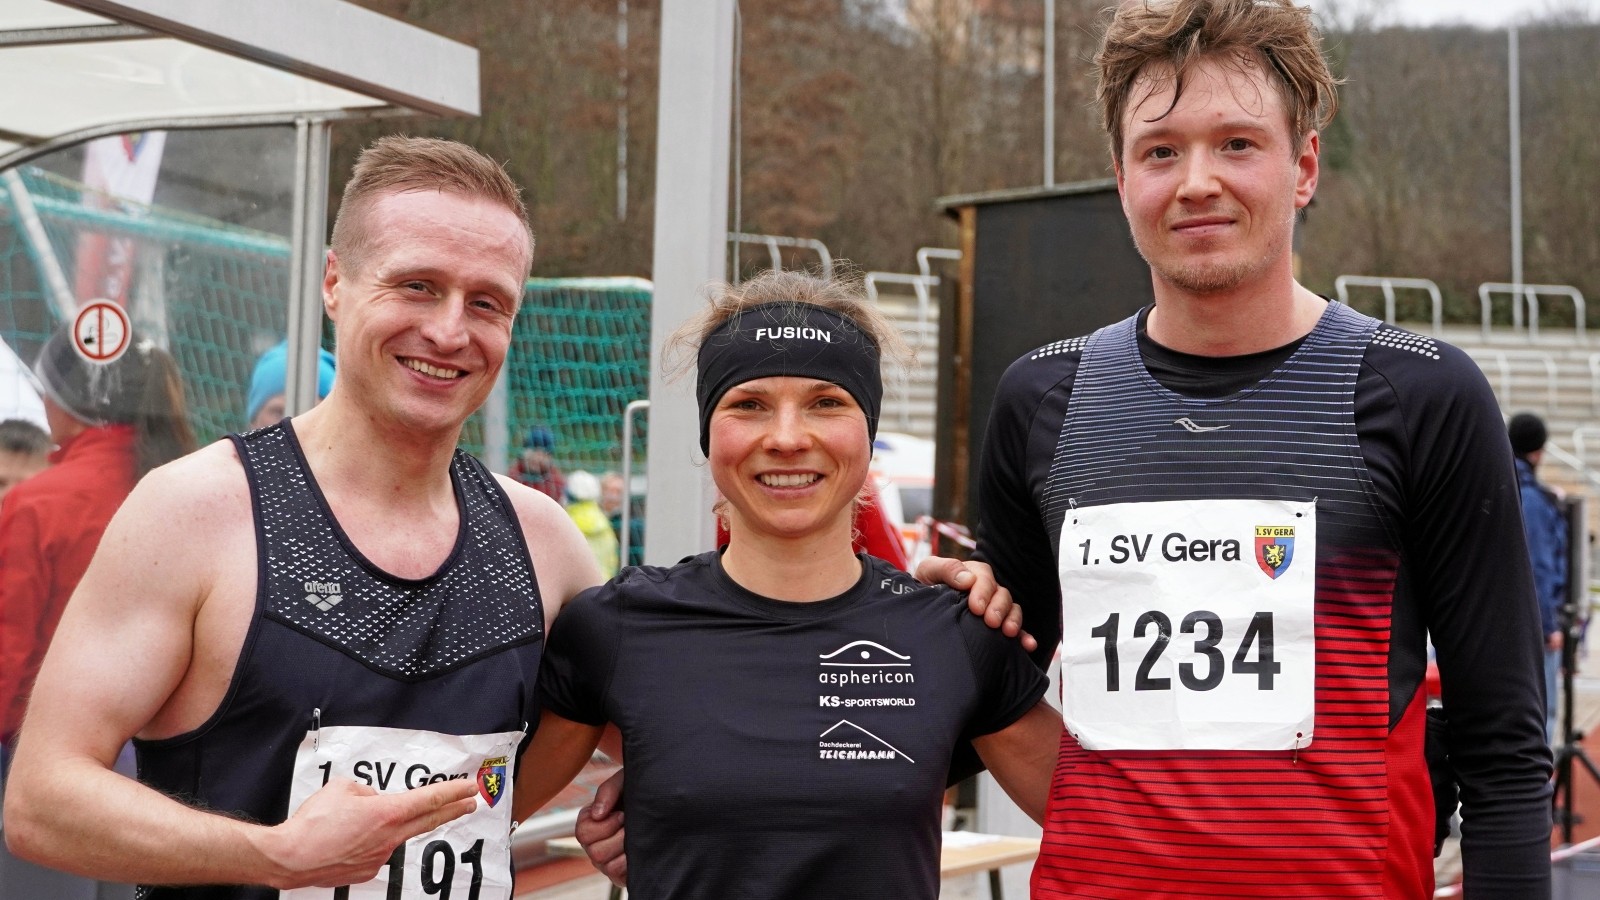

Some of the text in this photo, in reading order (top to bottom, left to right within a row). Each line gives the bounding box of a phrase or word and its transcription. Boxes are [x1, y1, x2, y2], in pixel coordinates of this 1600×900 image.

[756, 326, 831, 343] FUSION
[1256, 528, 1294, 536] 1. SV GERA
[1078, 532, 1242, 566] 1. SV Gera
[304, 581, 341, 594] arena
[1091, 610, 1282, 692] 1234
[818, 670, 915, 688] asphericon
[819, 695, 916, 708] KS-SPORTSWORLD
[819, 741, 862, 749] Dachdeckerei
[819, 750, 896, 760] TEICHMANN
[318, 760, 333, 788] 1
[353, 760, 398, 791] SV
[333, 838, 485, 900] 191
